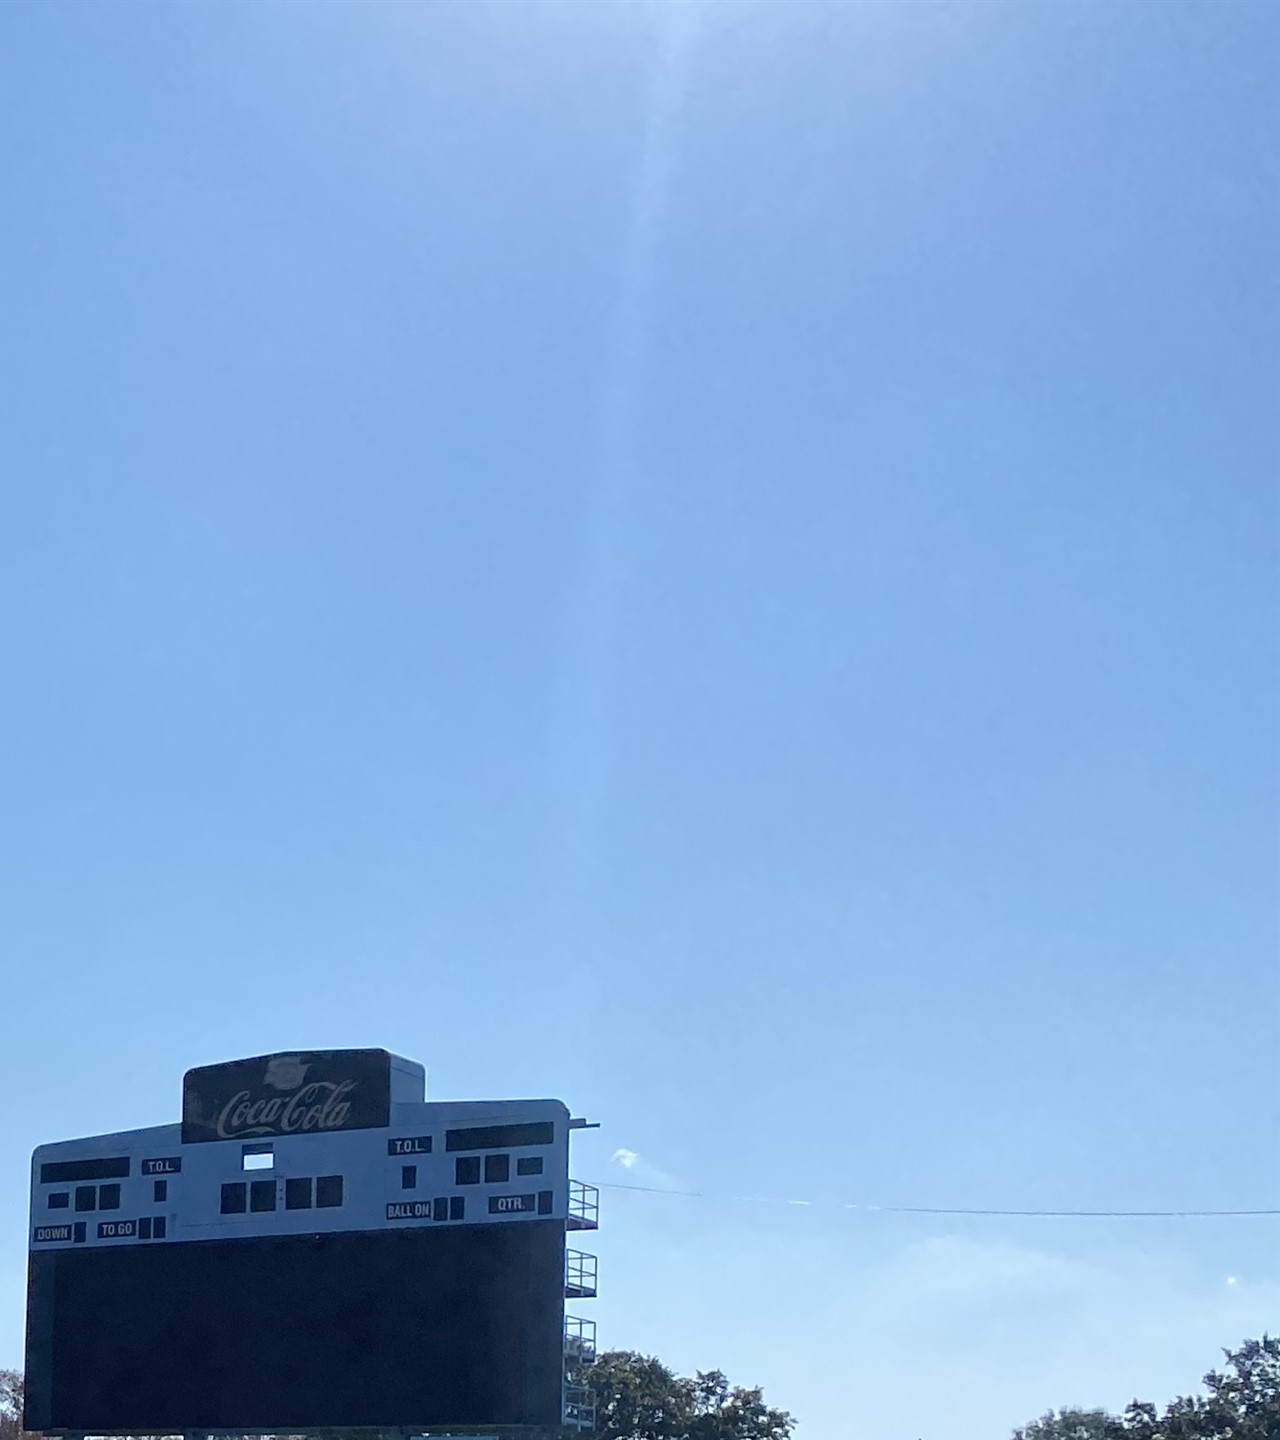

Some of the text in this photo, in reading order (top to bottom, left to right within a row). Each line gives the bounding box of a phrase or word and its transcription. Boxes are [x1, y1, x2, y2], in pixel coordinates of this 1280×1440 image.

[387, 1203, 430, 1218] BALL ON
[497, 1197, 526, 1211] QTR.
[37, 1226, 68, 1240] DOWN
[102, 1222, 133, 1236] TO GO
